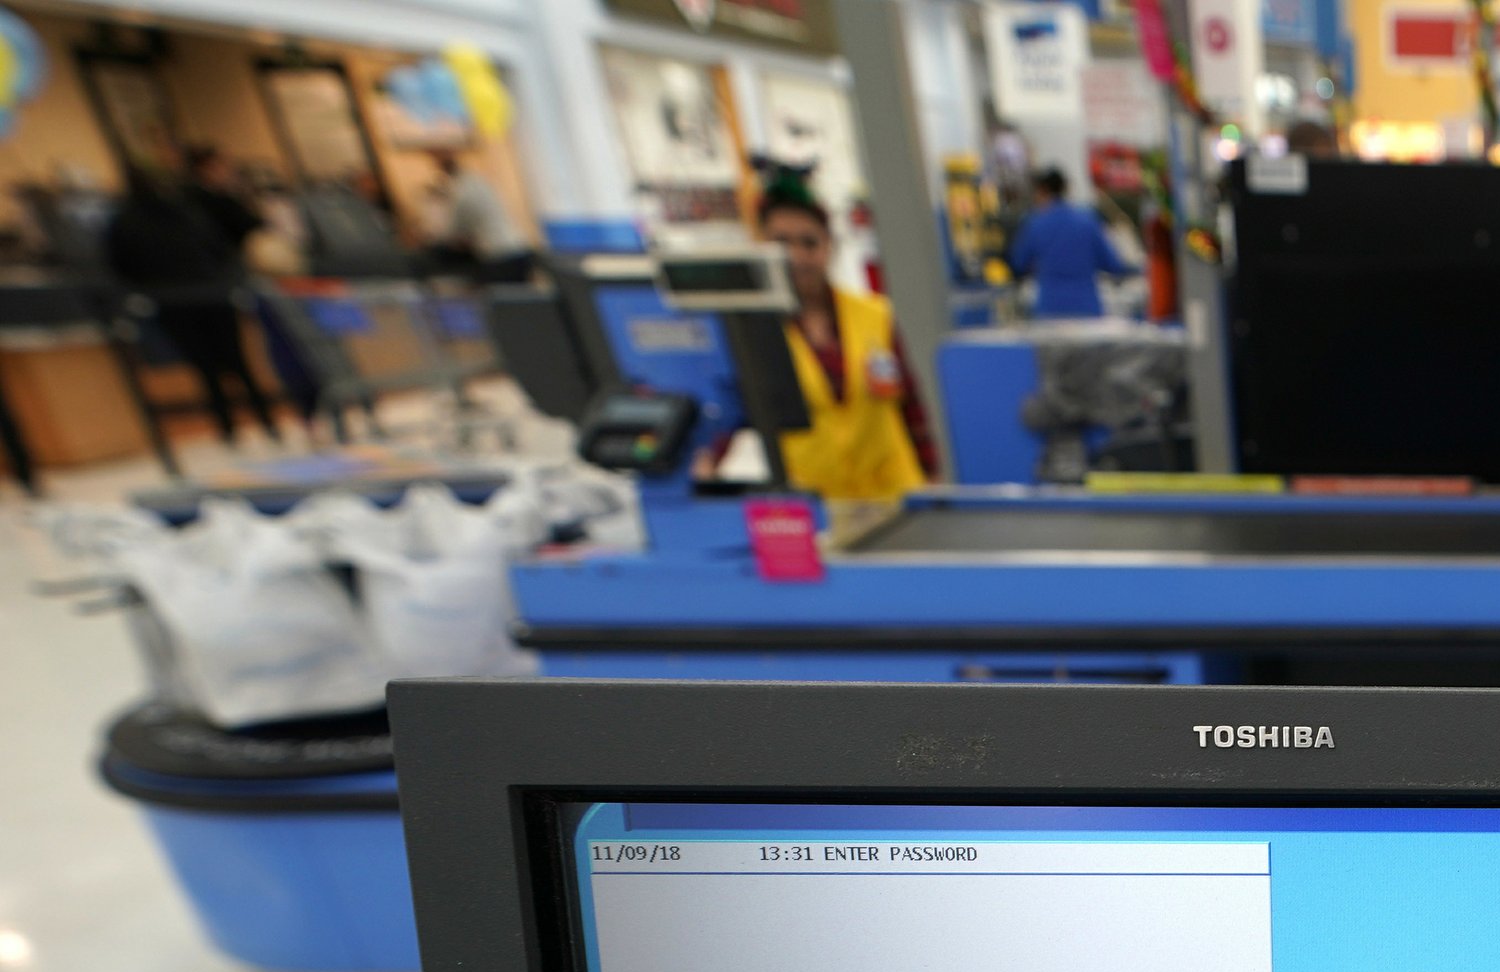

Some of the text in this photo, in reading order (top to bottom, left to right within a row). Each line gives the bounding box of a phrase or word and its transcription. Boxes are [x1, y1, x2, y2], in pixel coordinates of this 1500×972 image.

[1192, 725, 1335, 748] TOSHIBA
[592, 844, 978, 863] 11/09/18 13:31 ENTER PASSWORD
